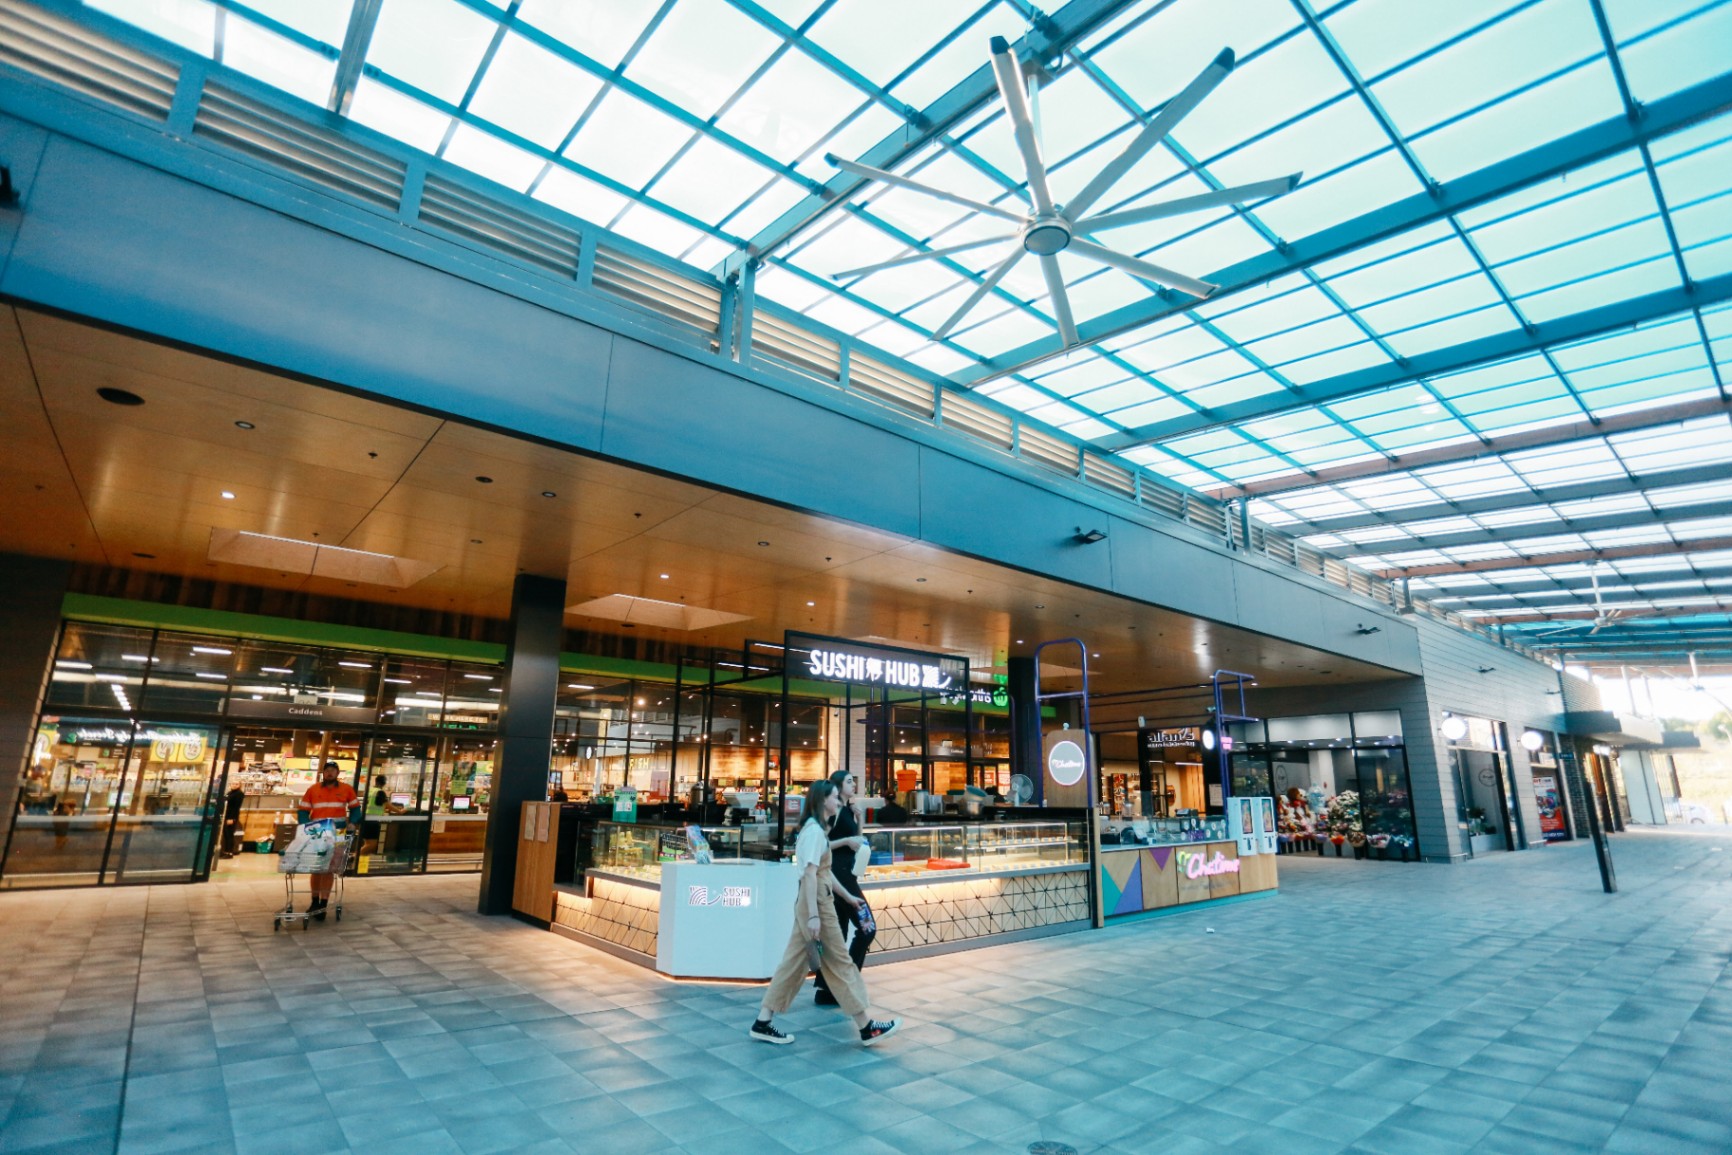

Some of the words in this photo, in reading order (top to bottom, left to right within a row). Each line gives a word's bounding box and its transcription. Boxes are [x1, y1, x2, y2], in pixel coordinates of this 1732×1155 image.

[809, 649, 866, 681] SUSHI
[885, 659, 919, 687] HUB
[288, 707, 323, 716] Caddens
[723, 887, 751, 897] SUSHI
[723, 897, 742, 906] HUB
